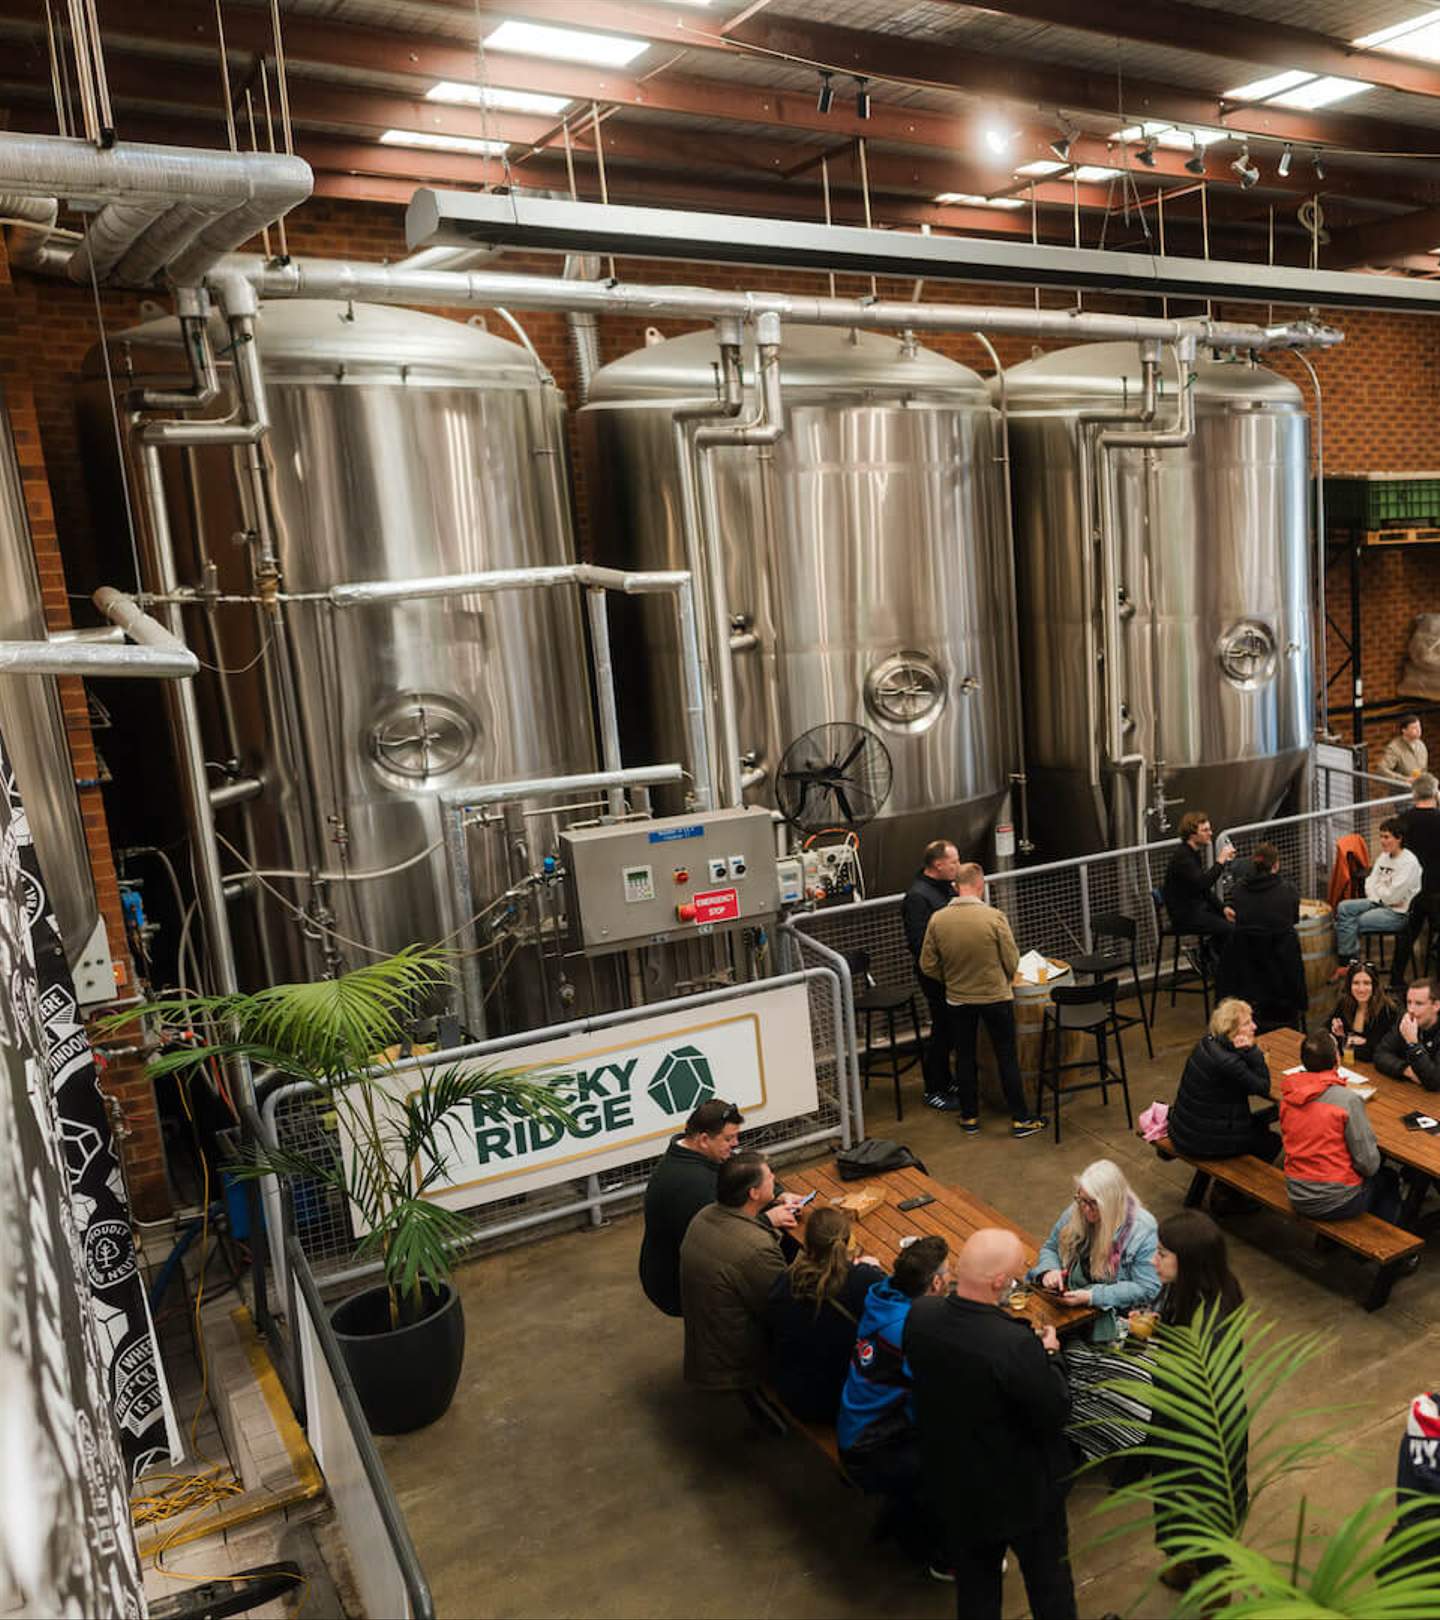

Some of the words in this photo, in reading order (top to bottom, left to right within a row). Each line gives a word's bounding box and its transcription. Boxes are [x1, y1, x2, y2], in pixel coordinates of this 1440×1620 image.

[696, 893, 734, 907] EMERGENCY
[708, 906, 725, 917] STOP
[475, 1094, 634, 1165] RIDGE
[134, 1399, 151, 1416] IS
